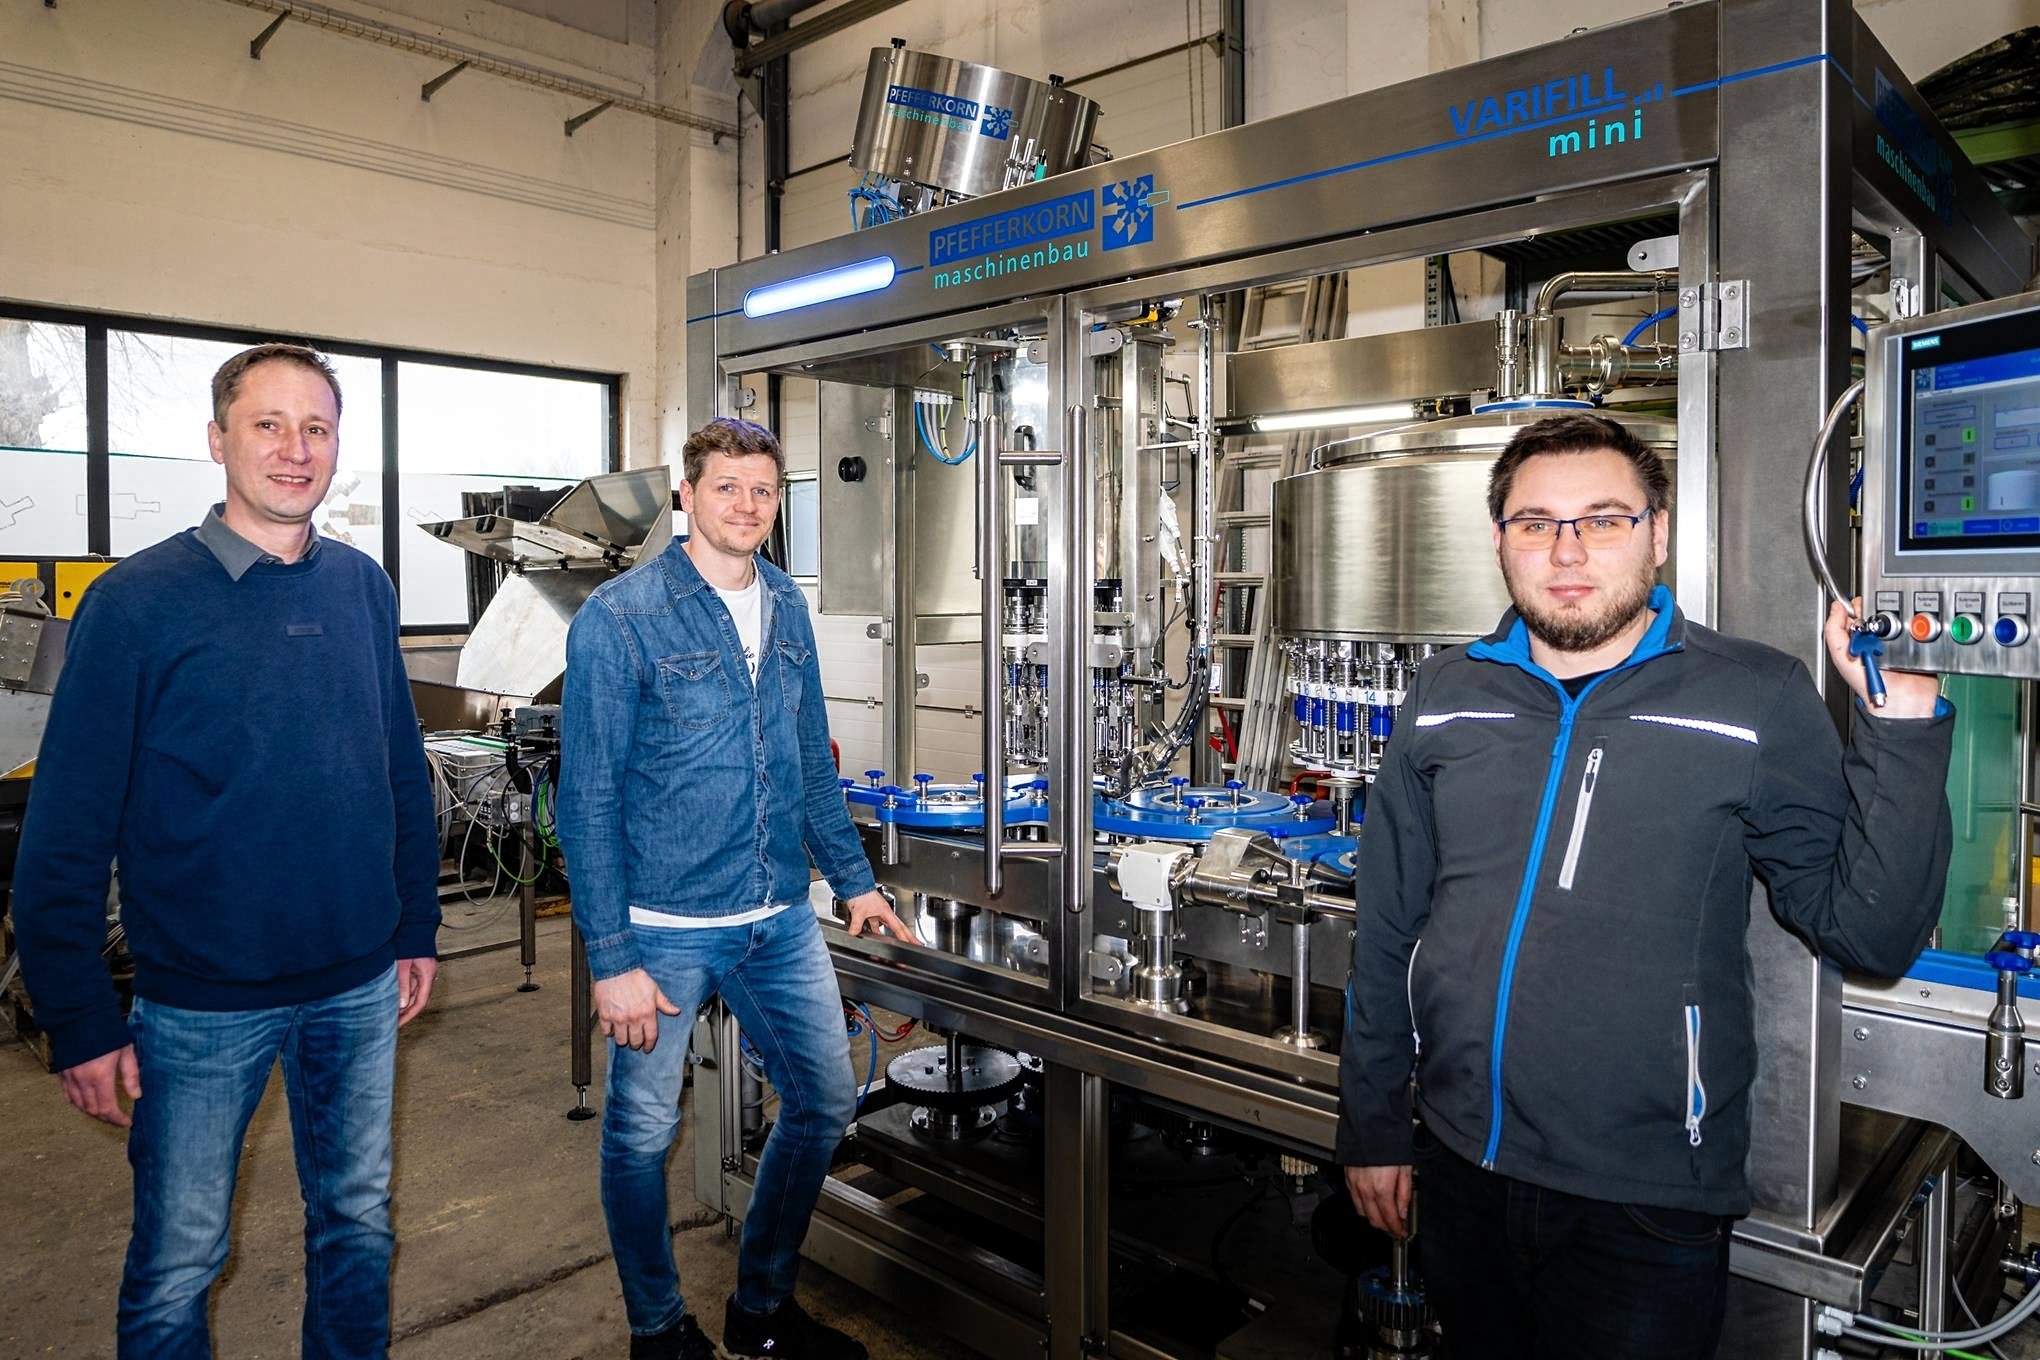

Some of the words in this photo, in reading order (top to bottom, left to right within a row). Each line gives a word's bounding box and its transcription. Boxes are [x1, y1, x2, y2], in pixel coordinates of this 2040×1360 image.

[1448, 67, 1627, 136] VARIFILL
[1550, 109, 1642, 157] mini
[1877, 134, 1935, 212] maschinenbau
[935, 198, 1088, 260] PFEFFERKORN
[934, 241, 1089, 289] maschinenbau
[1328, 687, 1338, 700] 15
[1364, 690, 1377, 703] 14
